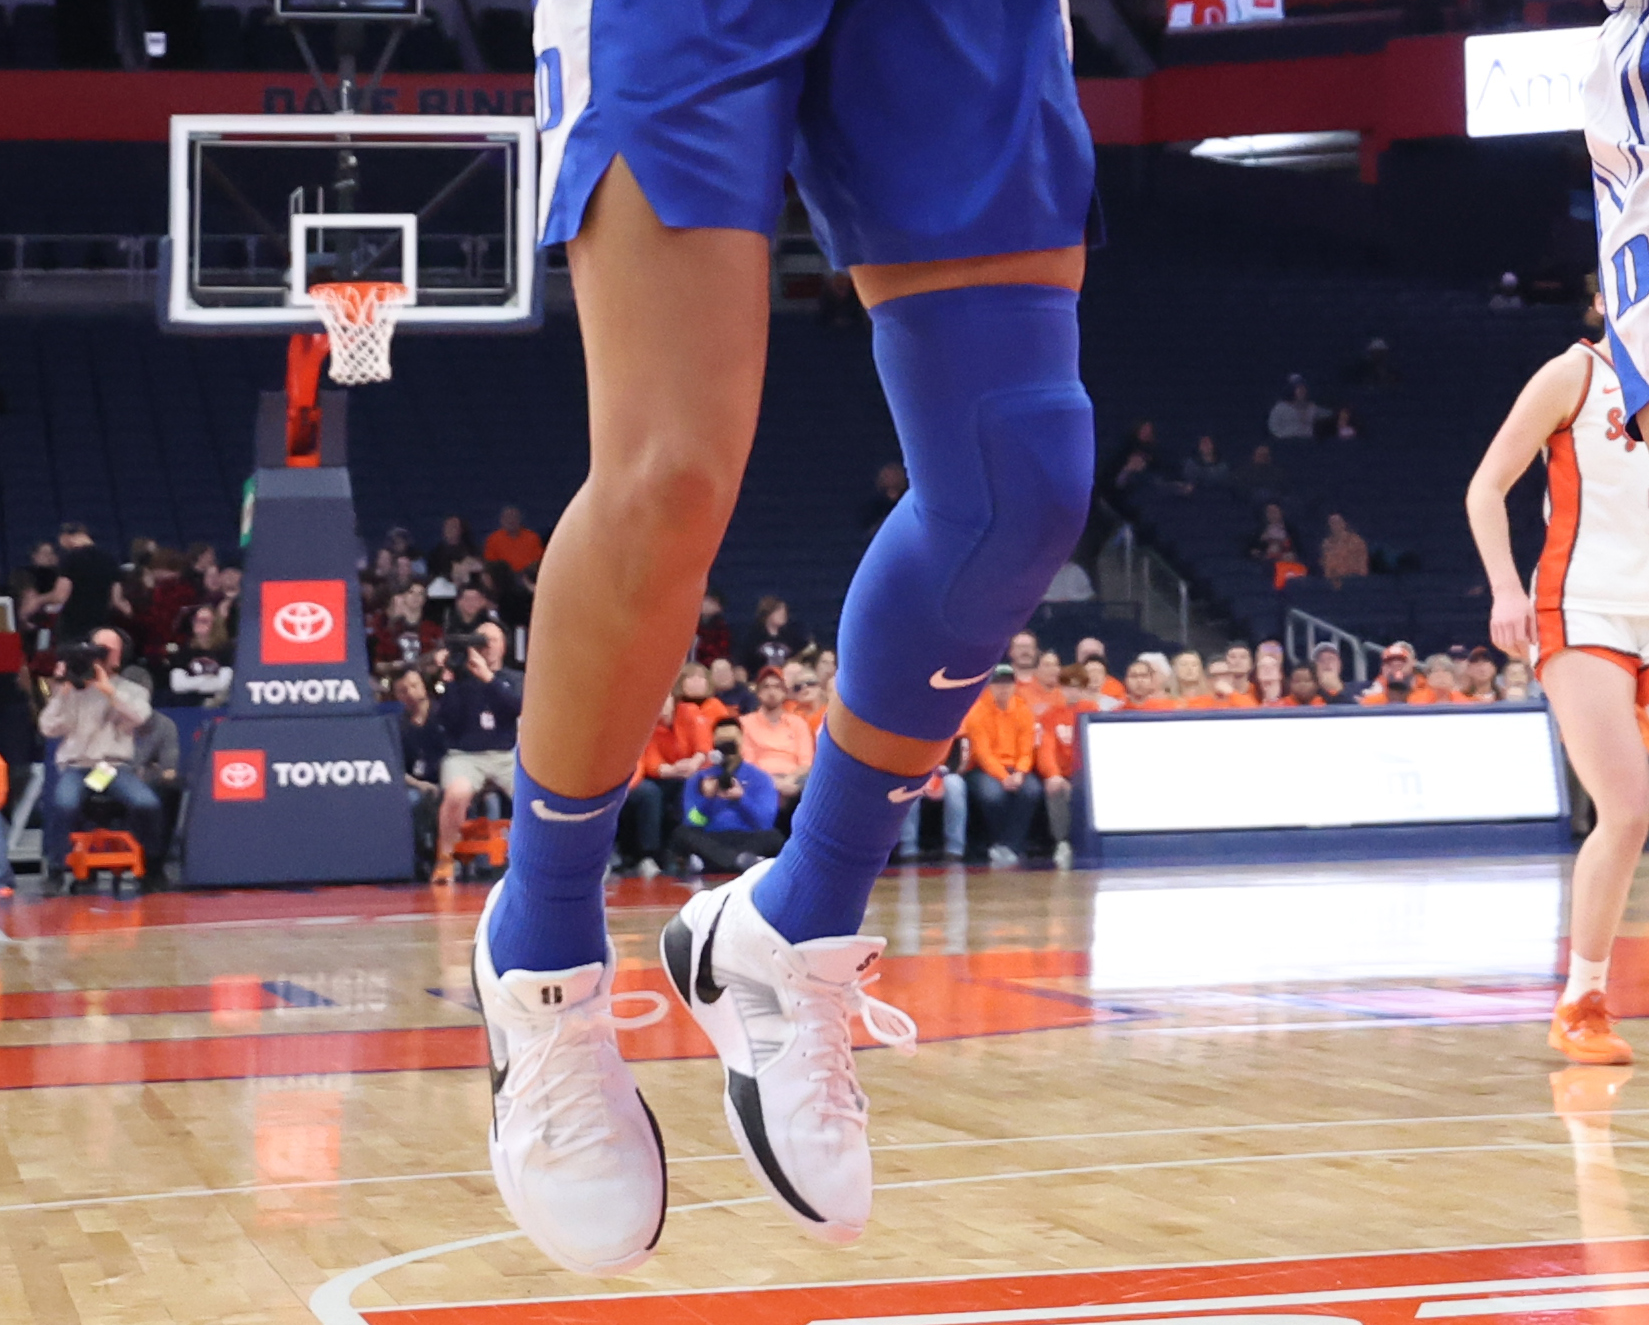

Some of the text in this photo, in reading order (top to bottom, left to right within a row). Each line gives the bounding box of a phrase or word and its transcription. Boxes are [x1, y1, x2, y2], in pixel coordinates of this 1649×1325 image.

[1476, 58, 1588, 110] Am
[245, 679, 361, 704] TOYOTA
[272, 760, 392, 787] TOYOTA
